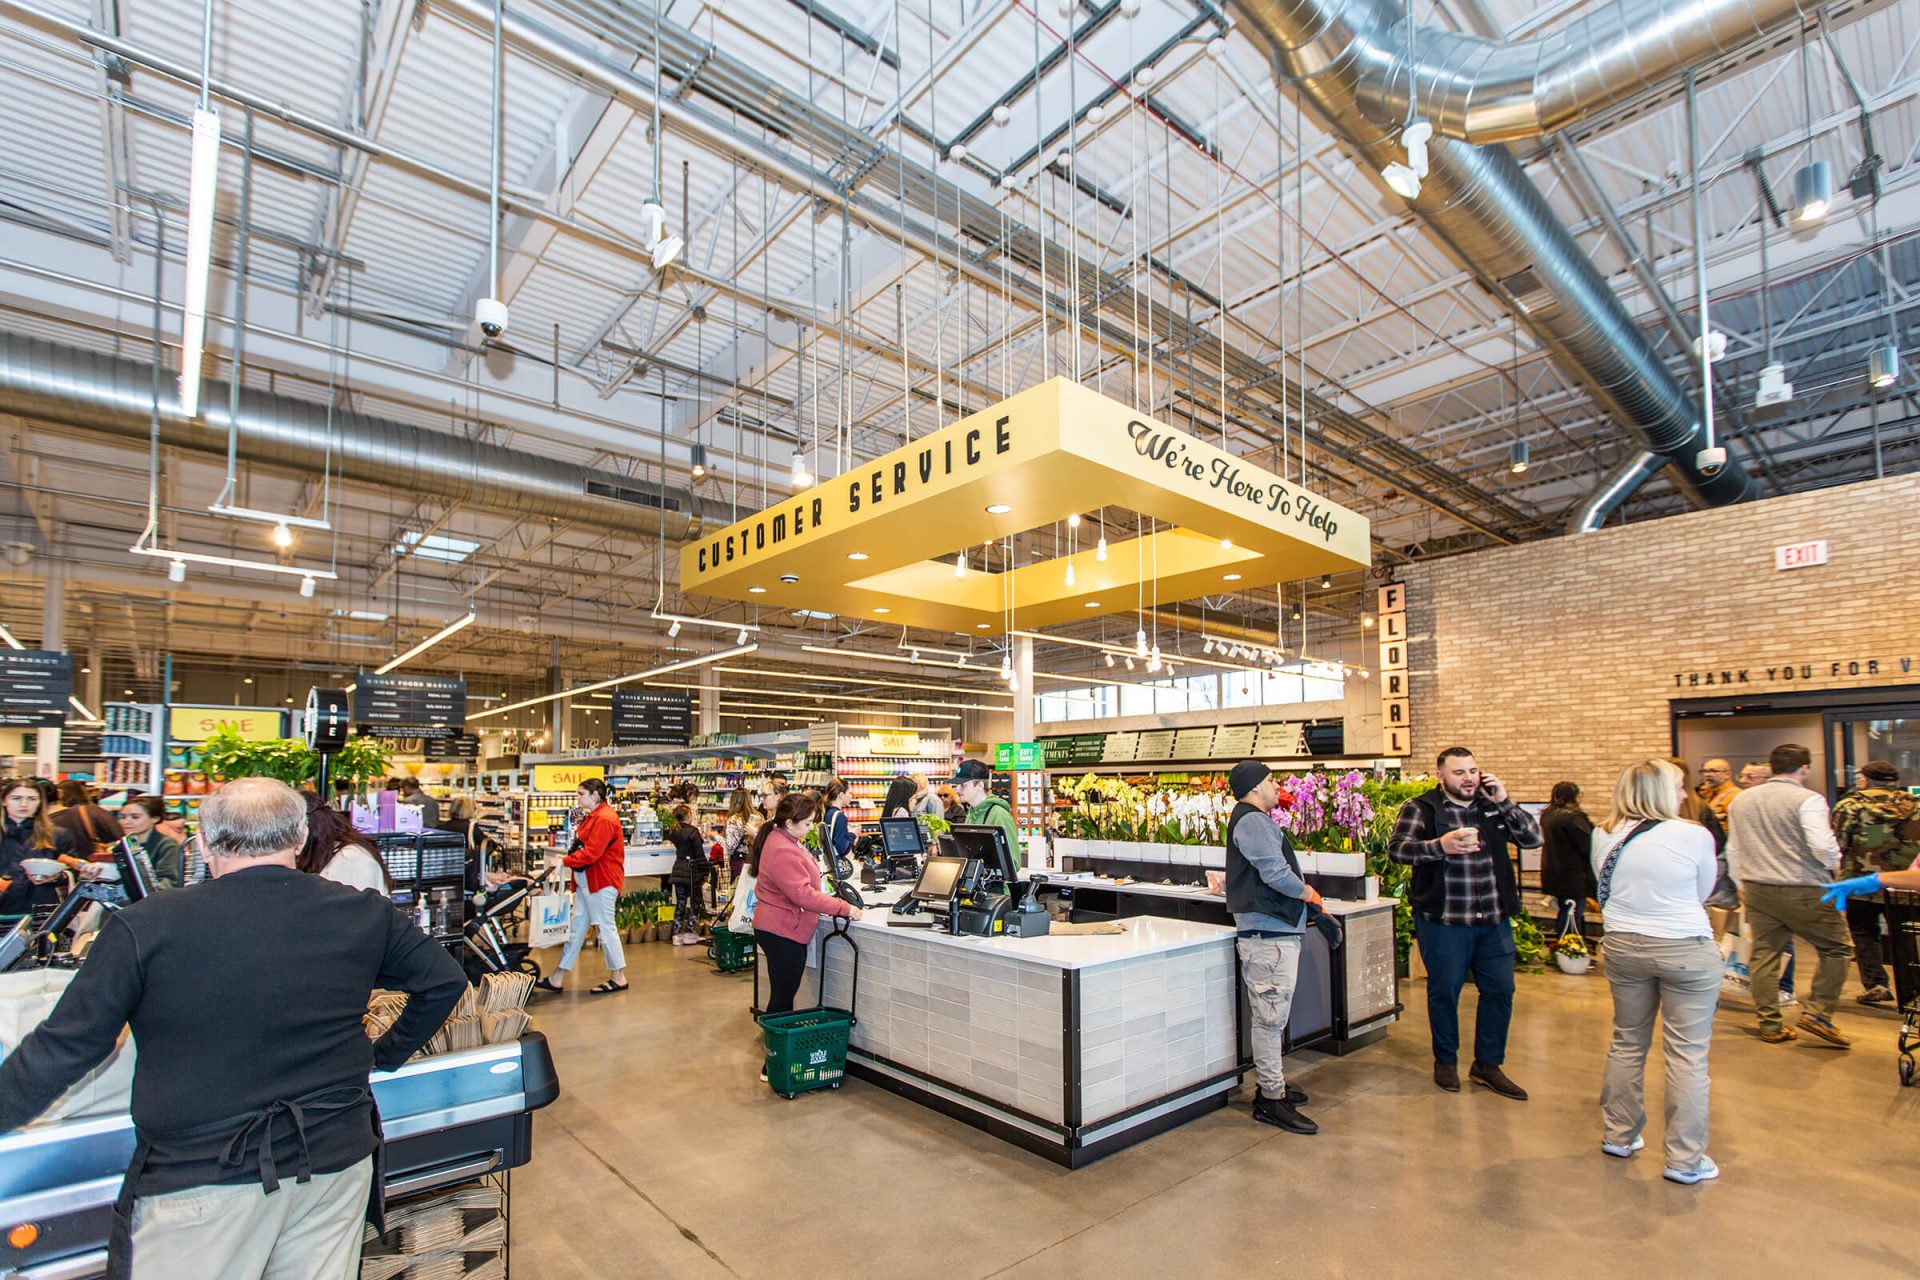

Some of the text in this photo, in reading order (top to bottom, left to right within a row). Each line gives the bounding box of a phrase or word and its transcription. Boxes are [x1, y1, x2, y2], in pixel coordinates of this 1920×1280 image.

[699, 415, 1010, 572] CUSTOMER SERVICE
[1127, 420, 1338, 542] We're Here To Help
[1784, 544, 1818, 566] EXIT
[1386, 589, 1402, 751] FLORAL
[1674, 670, 1749, 687] THANK
[1766, 665, 1812, 681] YOU
[1831, 659, 1880, 677] FOR
[200, 718, 254, 733] SE
[329, 703, 338, 737] ONE
[883, 736, 904, 747] SALE
